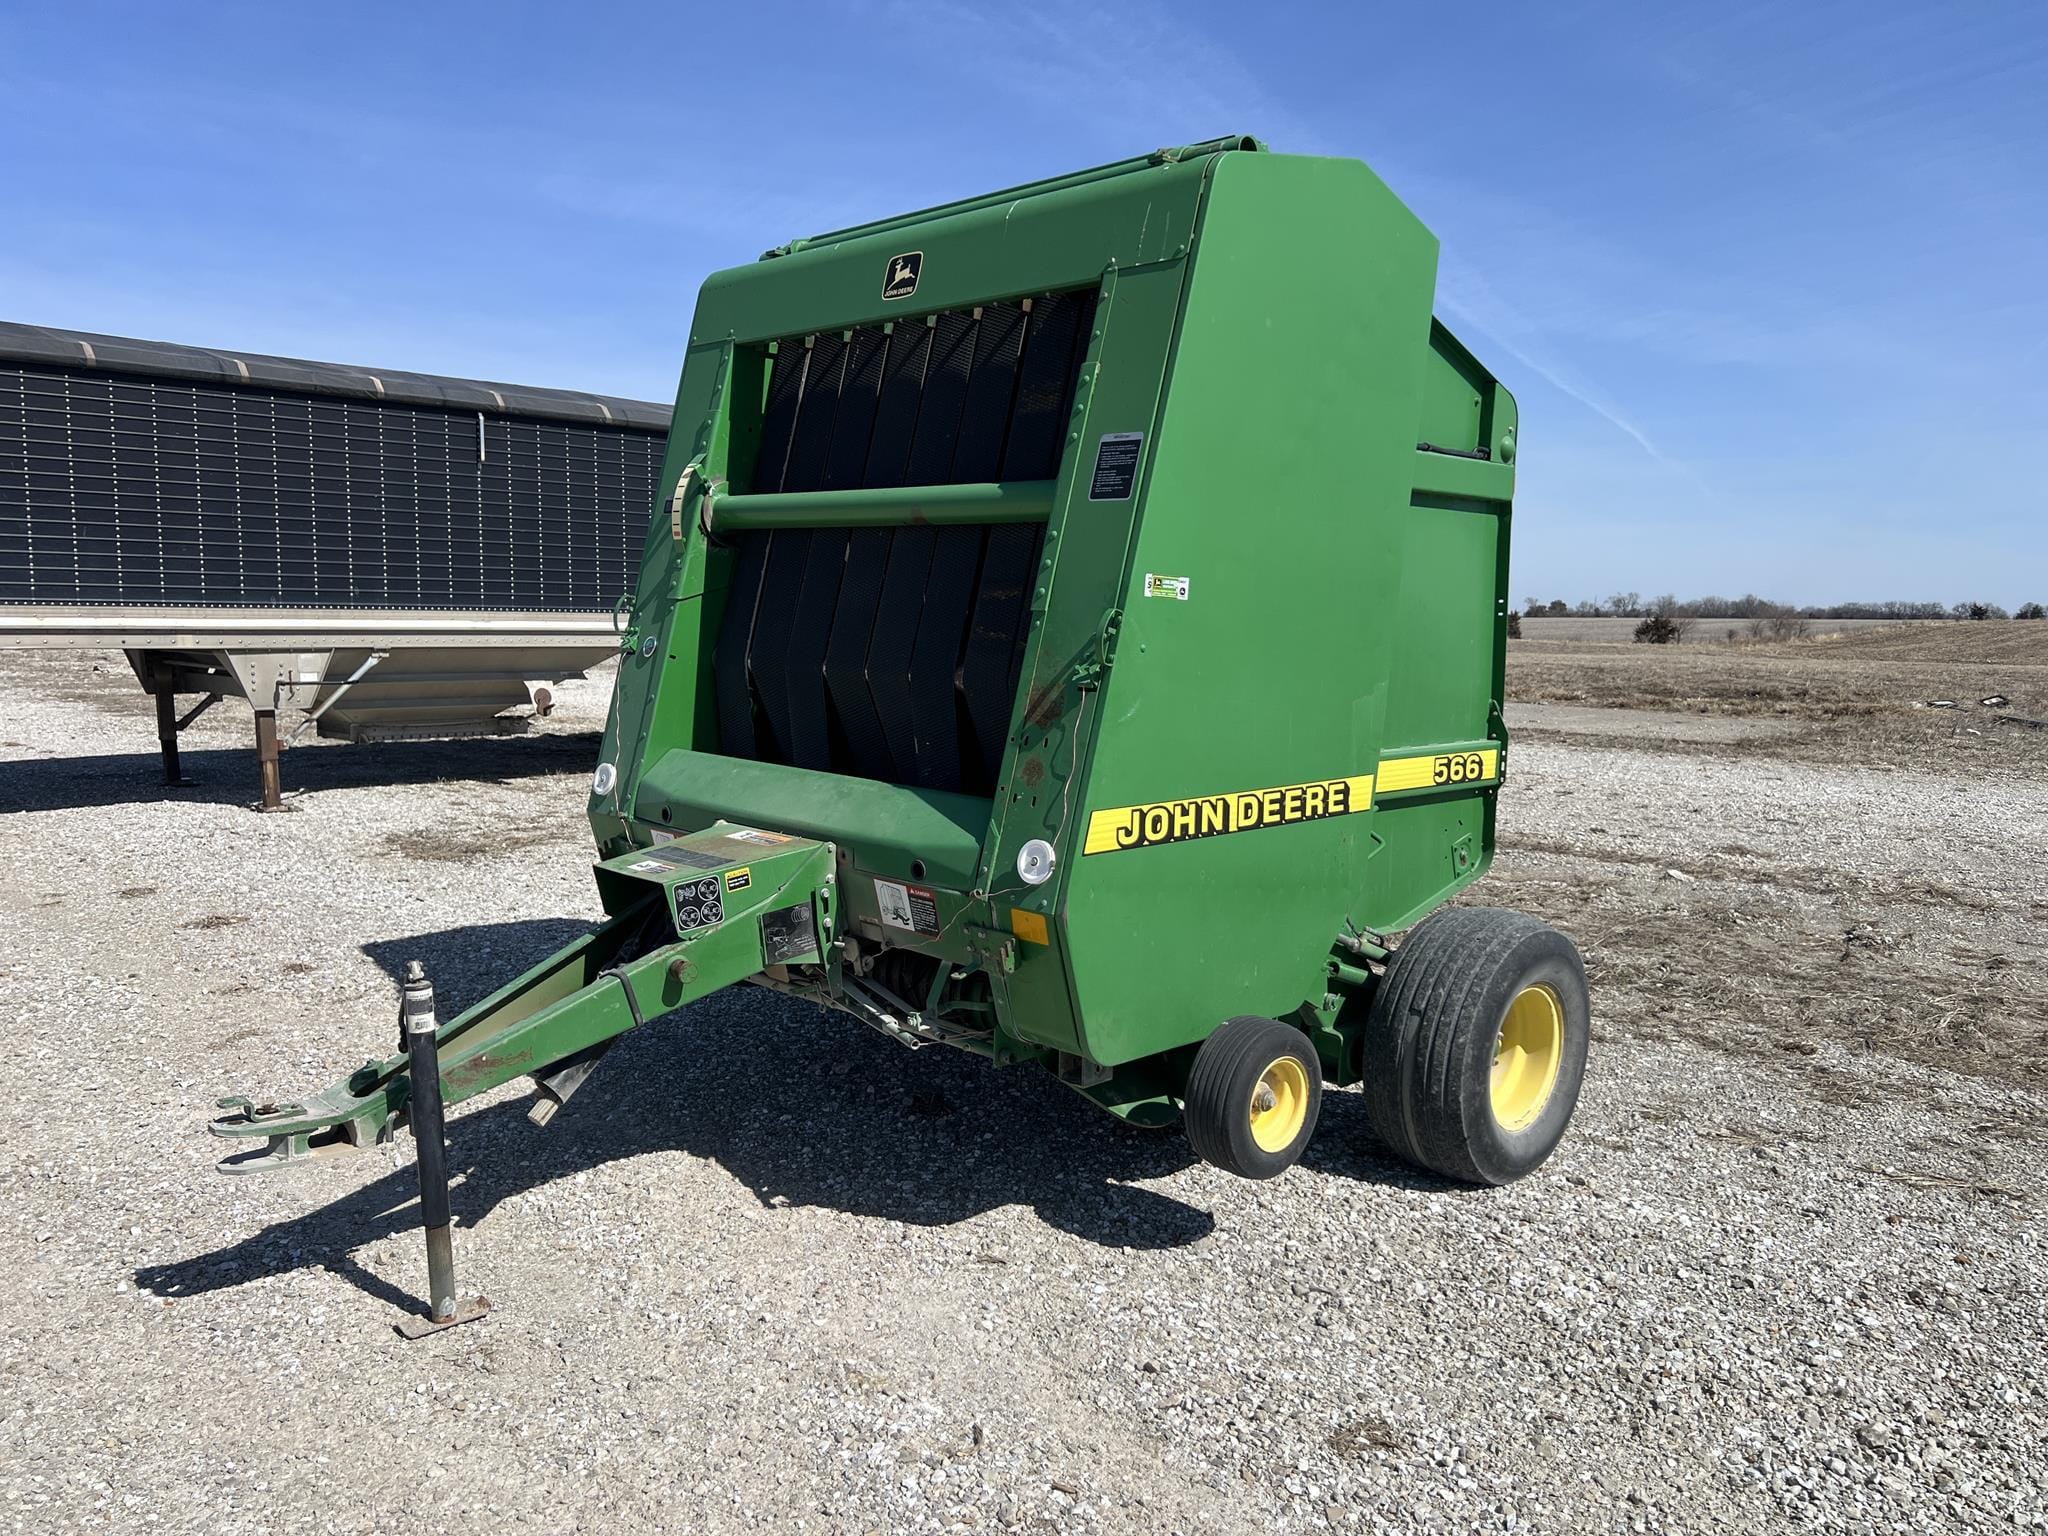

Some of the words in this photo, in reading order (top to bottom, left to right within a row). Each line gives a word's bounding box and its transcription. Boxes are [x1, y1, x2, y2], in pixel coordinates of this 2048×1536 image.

[884, 289, 898, 297] JOHN
[1433, 754, 1482, 783] 566
[1116, 799, 1229, 848] JOHN
[1236, 781, 1350, 827] DEERE
